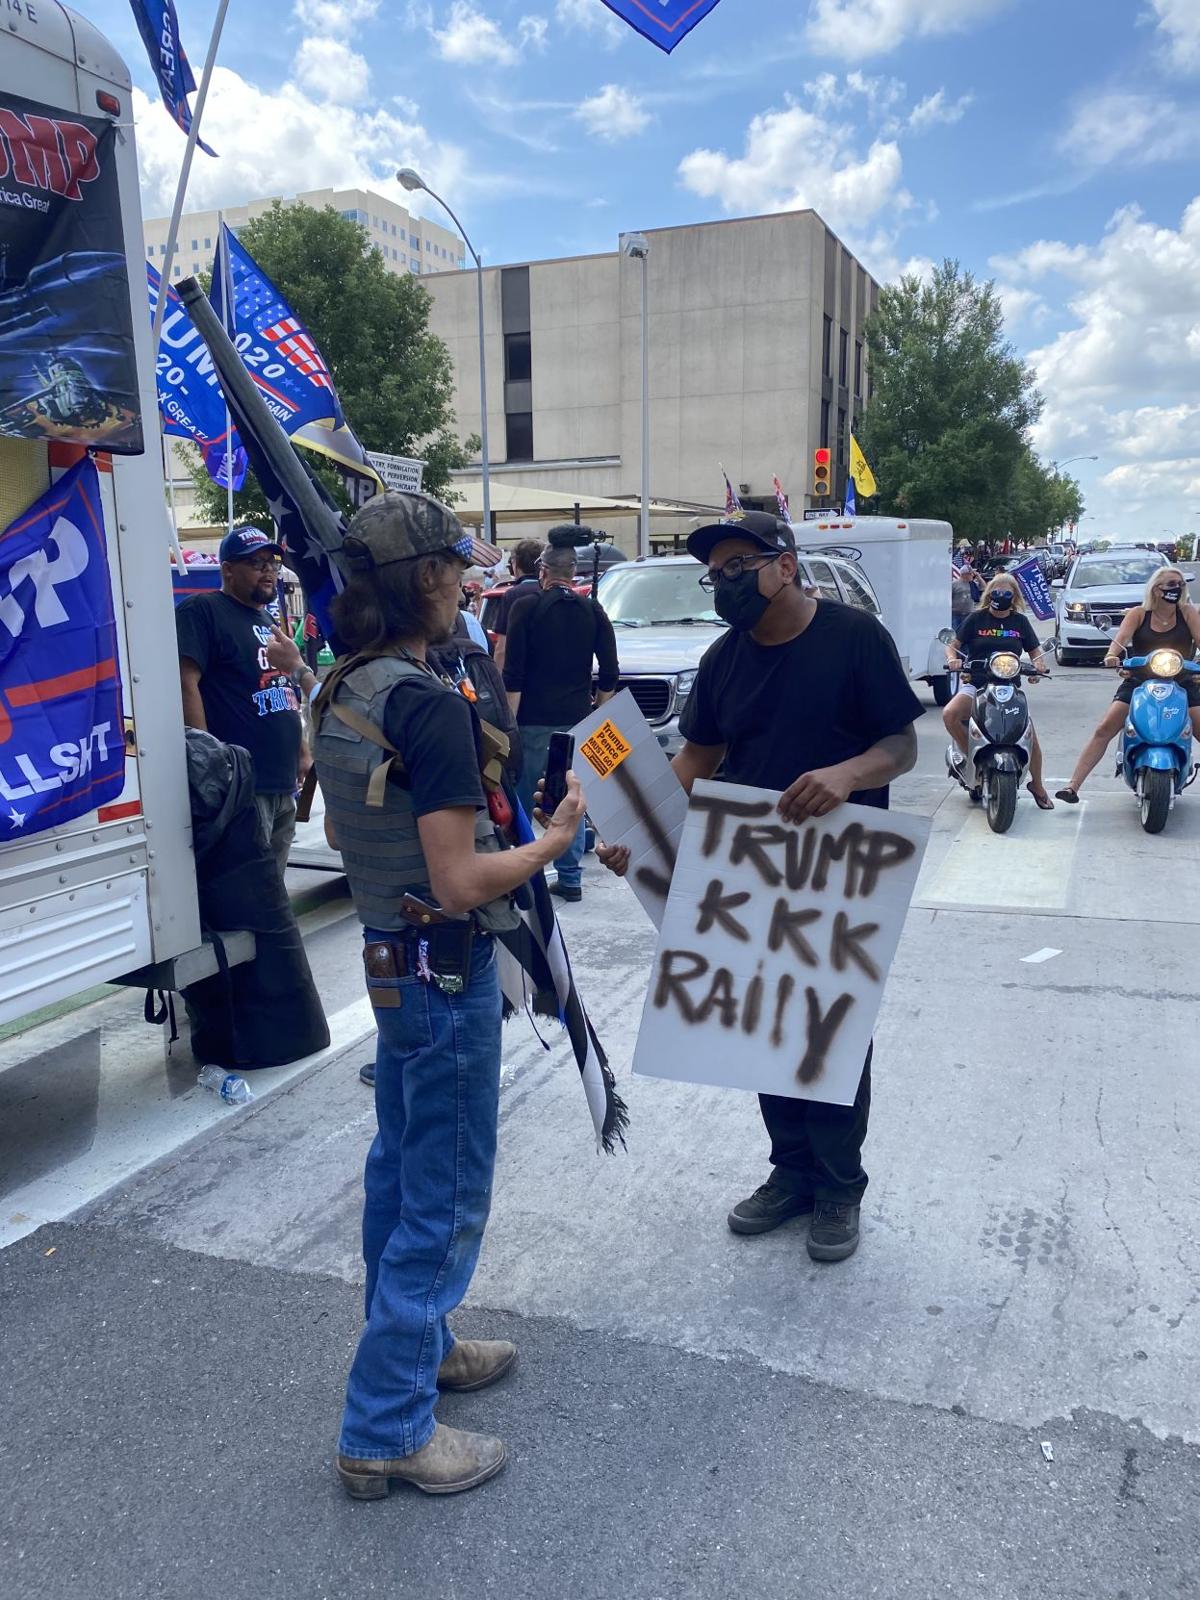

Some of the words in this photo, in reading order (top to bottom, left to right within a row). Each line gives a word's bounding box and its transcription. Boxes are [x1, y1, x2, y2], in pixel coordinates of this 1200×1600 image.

[1031, 565, 1055, 611] TRUMP
[587, 737, 606, 757] MUST
[602, 755, 615, 769] GO!
[596, 731, 619, 760] Pence
[603, 722, 630, 754] Trump/
[689, 795, 916, 898] TRUMP
